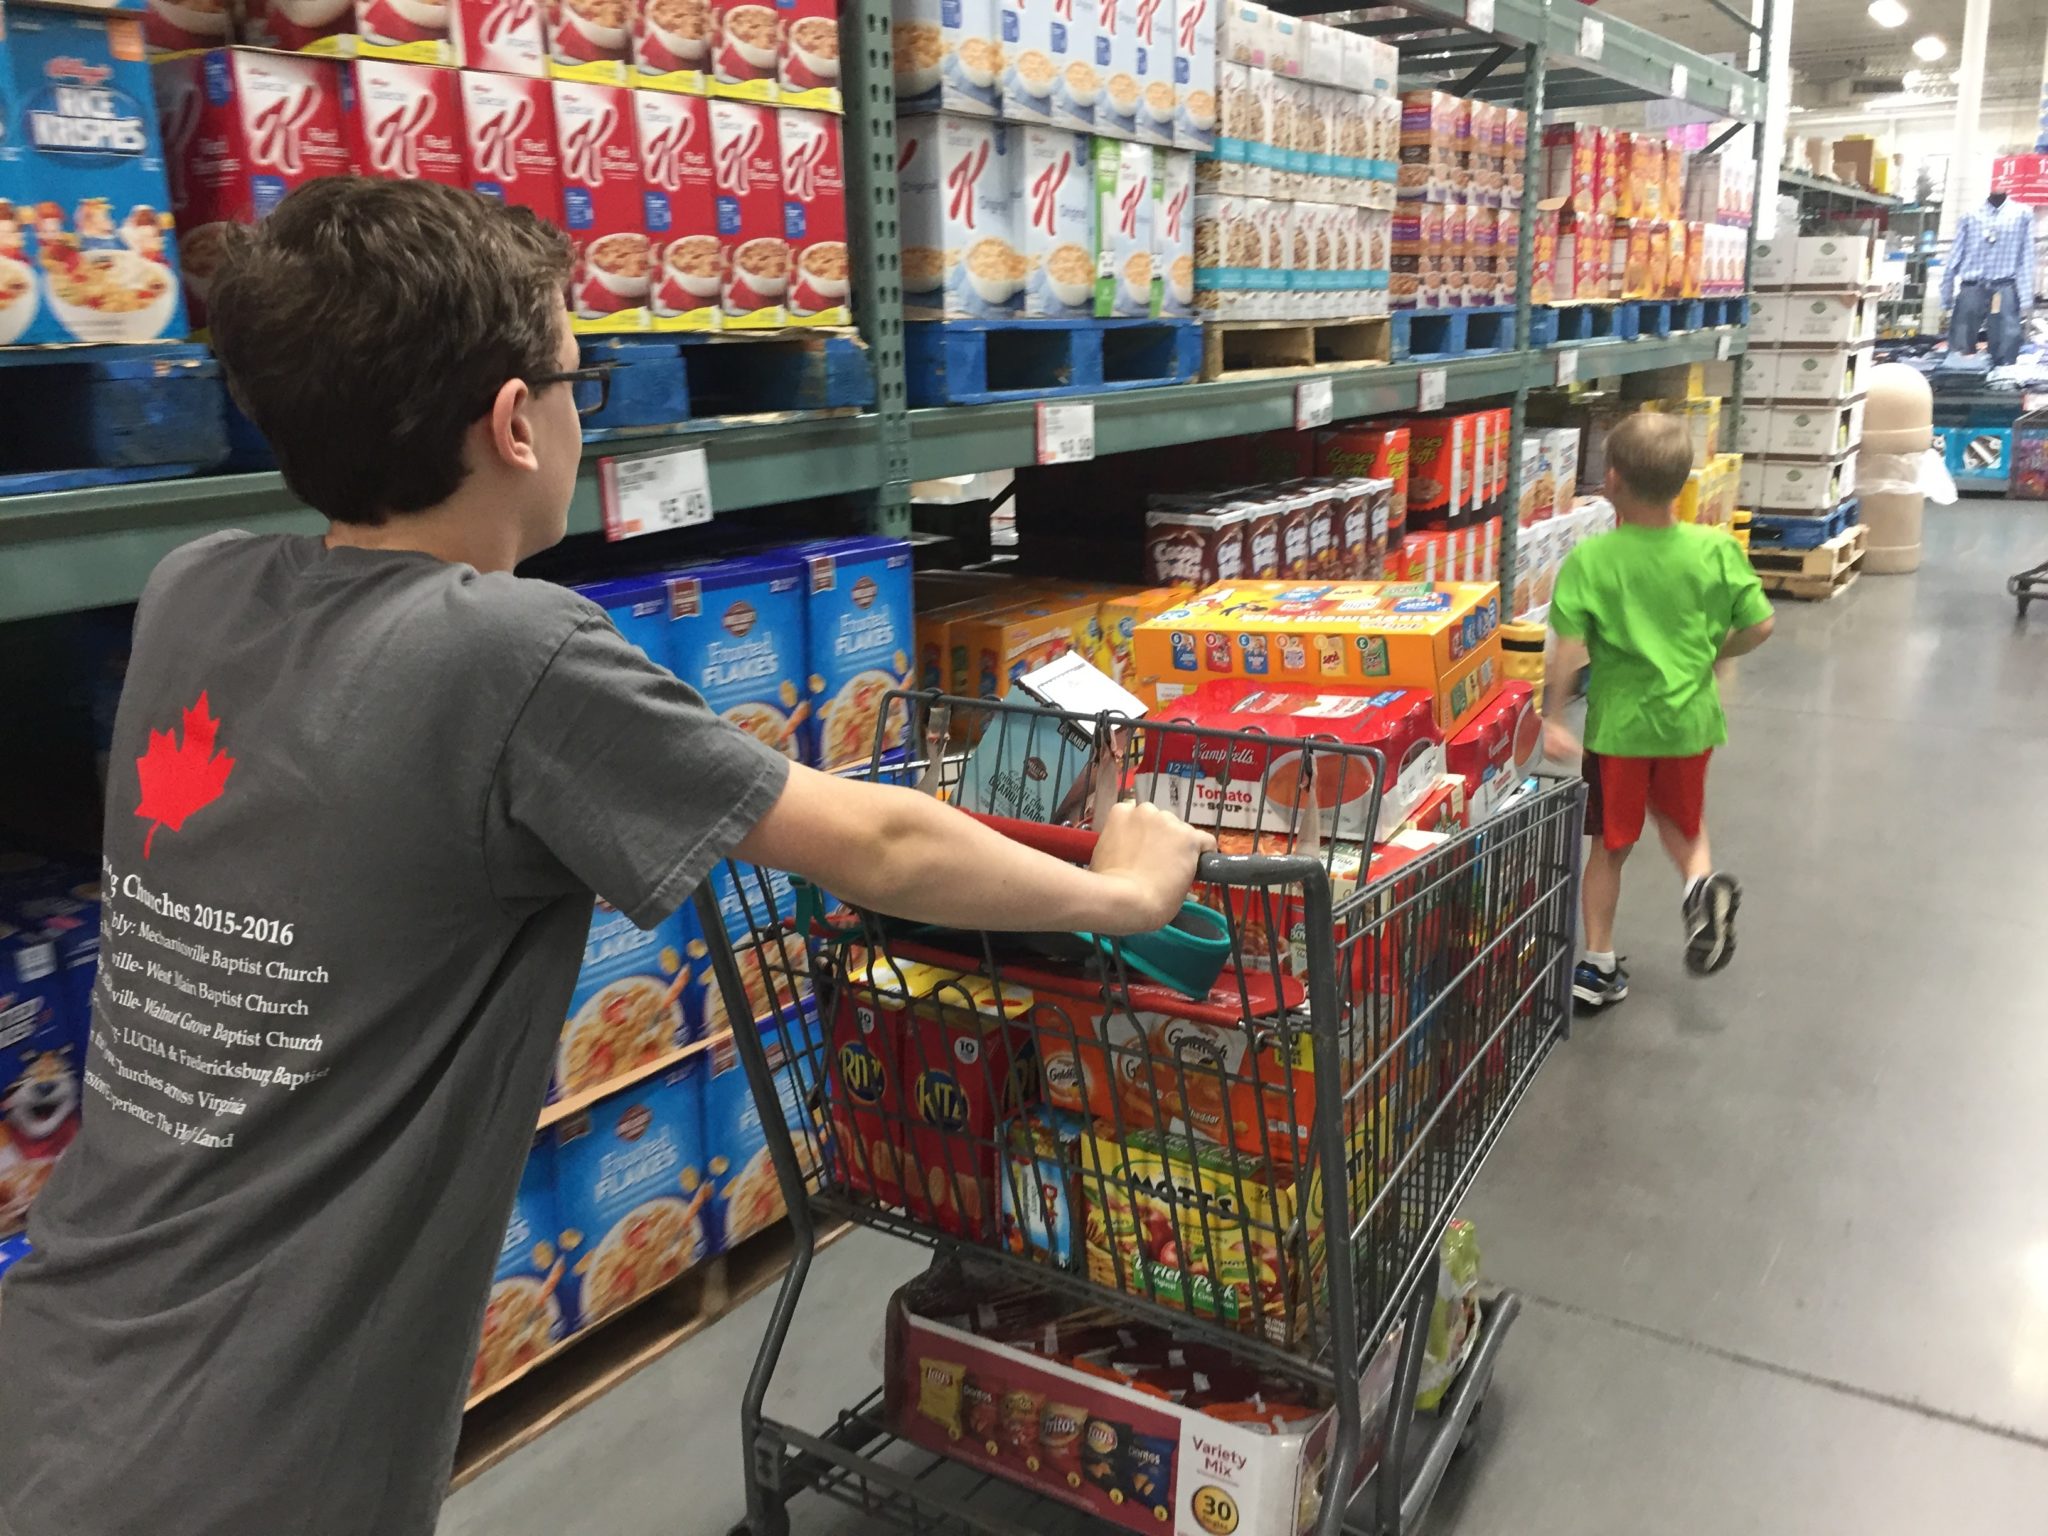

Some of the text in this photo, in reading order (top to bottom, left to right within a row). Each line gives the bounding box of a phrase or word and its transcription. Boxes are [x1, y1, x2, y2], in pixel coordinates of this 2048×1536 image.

[2002, 160, 2015, 175] 11
[703, 655, 778, 689] FLAKES
[193, 904, 295, 945] 2015-2016
[211, 950, 262, 976] Baptist
[265, 961, 329, 983] Church
[198, 982, 243, 1009] Baptist
[245, 994, 309, 1016] Church
[180, 1012, 211, 1037] Grove
[213, 1022, 261, 1048] Baptist
[266, 1031, 323, 1051] Church
[959, 1040, 975, 1054] 10
[123, 1027, 166, 1058] LUCHA
[179, 1049, 273, 1087] Fredericksburg
[197, 1091, 248, 1117] Virginia
[156, 1112, 174, 1135] The
[193, 1128, 235, 1148] Land
[1192, 1435, 1248, 1470] Variety
[1204, 1457, 1232, 1478] Mix
[1203, 1495, 1232, 1521] 30
